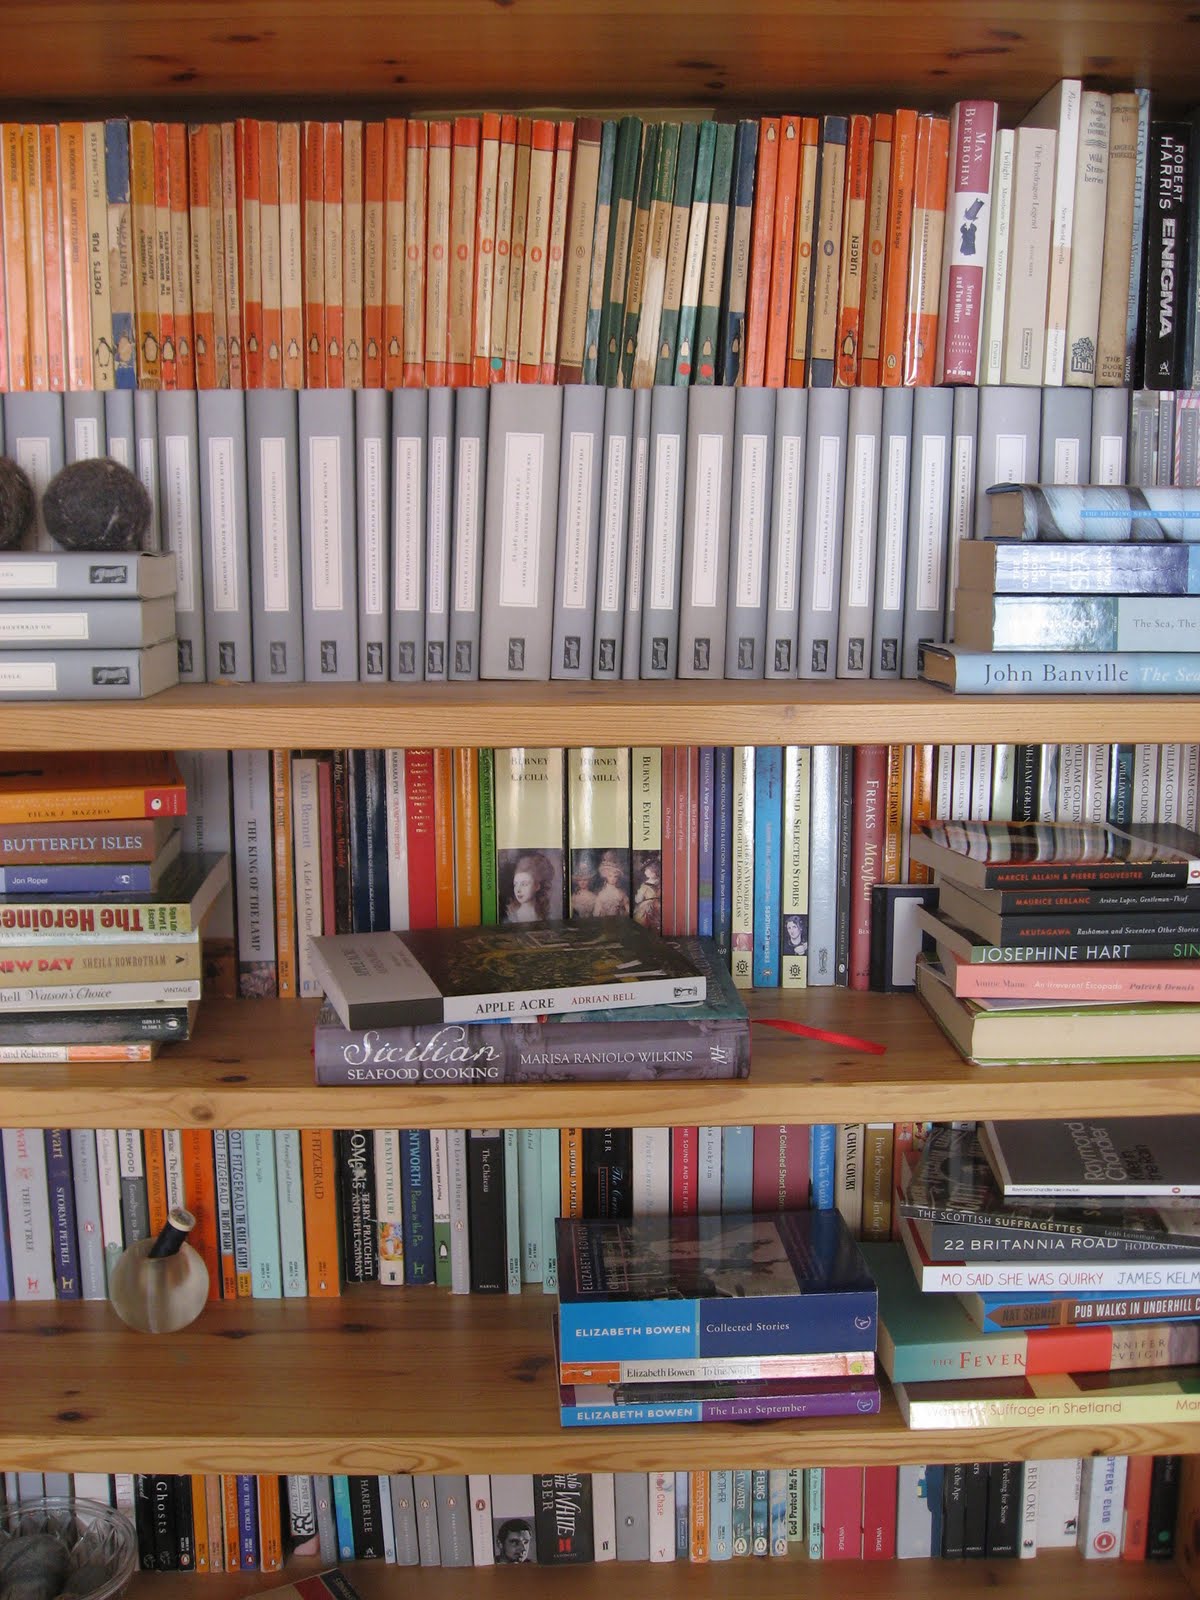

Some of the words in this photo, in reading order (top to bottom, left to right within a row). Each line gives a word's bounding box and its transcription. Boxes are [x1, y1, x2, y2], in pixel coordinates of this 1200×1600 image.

[961, 108, 976, 186] BEERBOHM
[975, 132, 986, 162] MAX
[1034, 146, 1042, 159] The
[1031, 161, 1041, 199] Pendragon
[1159, 137, 1172, 209] HARRIS
[1173, 145, 1183, 202] ROBERT
[1030, 203, 1039, 229] Legend
[92, 232, 100, 252] PUB
[636, 223, 645, 253] CURVES
[673, 214, 682, 253] SPORTSMAN
[671, 257, 677, 266] NO
[849, 235, 859, 276] JURGEN
[93, 261, 101, 295] POET'S
[633, 256, 641, 302] DANGEROUS
[955, 276, 964, 288] and
[1159, 218, 1175, 338] ENIGMA
[965, 285, 975, 303] Seven
[953, 303, 963, 323] Others
[965, 304, 973, 316] Men
[1134, 619, 1151, 628] The
[1154, 619, 1175, 630] Sea,
[1177, 619, 1195, 628] The
[984, 664, 1032, 685] John
[1043, 663, 1129, 682] Banville
[1140, 667, 1168, 681] The
[642, 756, 651, 794] BURNEY
[1064, 759, 1072, 784] Down
[1188, 745, 1196, 787] WILLIAM
[300, 769, 312, 799] Alan
[865, 780, 879, 829] FREAKS
[1063, 786, 1071, 811] Below
[1186, 789, 1194, 831] GOLDING
[247, 820, 256, 842] THE
[301, 803, 313, 849] Bennett
[643, 802, 652, 842] EVELINA
[3, 836, 96, 852] BUTTERFLY
[101, 836, 143, 850] ISLES
[792, 819, 802, 866] SELECTED
[248, 846, 257, 873] KING
[12, 877, 26, 885] Jon
[27, 876, 48, 886] Roper
[249, 877, 258, 890] OF
[792, 868, 801, 907] STORIES
[997, 873, 1028, 881] MARCEL
[1031, 872, 1060, 881] ALLAIN
[1071, 872, 1096, 880] PIERRE
[1099, 871, 1143, 879] SOUVESTRE
[250, 896, 259, 918] THE
[1016, 897, 1052, 906] MAURICE
[1054, 897, 1090, 905] LEBLANC
[1099, 896, 1120, 904] Arsène
[101, 908, 144, 932] The
[1020, 928, 1071, 936] AKUTAGAWA
[1111, 927, 1123, 935] and
[1125, 927, 1155, 935] Seventeen
[1158, 926, 1176, 934] Other
[250, 920, 260, 951] LAMP
[38, 958, 74, 973] DAY
[82, 955, 112, 970] SHEILA
[114, 955, 167, 968] ROWBOTHAM
[979, 945, 1078, 963] JOSEPHINE
[1086, 944, 1132, 959] HART
[27, 988, 76, 1002] Watson's
[78, 988, 112, 999] Choice
[163, 985, 192, 993] VINTAGE
[475, 1000, 516, 1014] APPLE
[519, 997, 555, 1011] ACRE
[571, 994, 609, 1005] ADRIAN
[612, 992, 636, 1002] BELL
[340, 1026, 499, 1065] Sicilian
[520, 1053, 570, 1065] MARISA
[573, 1052, 635, 1065] RANIOLO
[638, 1050, 693, 1063] WILKINS
[347, 1068, 419, 1081] SEAFOOD
[423, 1067, 499, 1080] COOKING
[482, 1149, 490, 1162] The
[846, 1132, 857, 1161] CHINA
[312, 1139, 323, 1199] FITZGERALD
[483, 1163, 491, 1192] Château
[846, 1163, 856, 1191] COURT
[233, 1154, 244, 1211] FITZGERALD
[56, 1187, 67, 1228] STORMY
[352, 1193, 360, 1213] AND
[362, 1193, 370, 1220] TERRY
[236, 1214, 245, 1224] THE
[353, 1215, 361, 1238] NEIL
[918, 1209, 937, 1219] THE
[941, 1211, 991, 1225] SCOTTISH
[995, 1218, 1082, 1234] SUFFRAGETTES
[236, 1226, 246, 1244] GREAT
[944, 1239, 965, 1250] 22
[971, 1239, 1064, 1250] BRITANNIA
[1071, 1238, 1118, 1248] ROAD
[60, 1230, 70, 1265] PETREL
[237, 1247, 248, 1268] GATSBY
[354, 1239, 362, 1276] GAIMAN
[363, 1225, 372, 1276] PRATCHETT
[941, 1273, 962, 1286] MO
[966, 1273, 994, 1285] SAID
[998, 1273, 1024, 1286] SHE
[1028, 1272, 1054, 1285] WAS
[1059, 1272, 1104, 1287] QUIRKY
[1117, 1272, 1161, 1285] JAMES
[1074, 1304, 1092, 1318] PUB
[1096, 1303, 1126, 1317] WALKS
[1130, 1302, 1139, 1314] IN
[1143, 1299, 1191, 1313] UNDERHILL
[575, 1327, 641, 1337] ELIZABETH
[646, 1325, 691, 1335] BOWEN
[706, 1323, 752, 1333] Collected
[756, 1322, 790, 1331] Stories
[627, 1367, 666, 1377] Elizabeth
[667, 1367, 695, 1377] Bowen
[960, 1351, 1027, 1369] FEVER
[577, 1409, 643, 1420] ELIZABETH
[648, 1408, 692, 1418] BOWEN
[708, 1406, 727, 1416] The
[731, 1405, 751, 1415] Last
[756, 1404, 806, 1415] September
[990, 1402, 1045, 1416] Suffrage
[1049, 1402, 1061, 1414] in
[1064, 1401, 1121, 1413] Shetland
[789, 1478, 797, 1490] Me
[1027, 1467, 1037, 1490] BEN
[156, 1482, 167, 1534] Ghosts
[360, 1480, 370, 1516] HARPER
[657, 1494, 665, 1516] Chase
[789, 1492, 797, 1518] Protect
[1026, 1494, 1036, 1522] OKRI
[364, 1517, 372, 1532] LEE
[555, 1491, 582, 1536] WHITE
[789, 1521, 797, 1535] God
